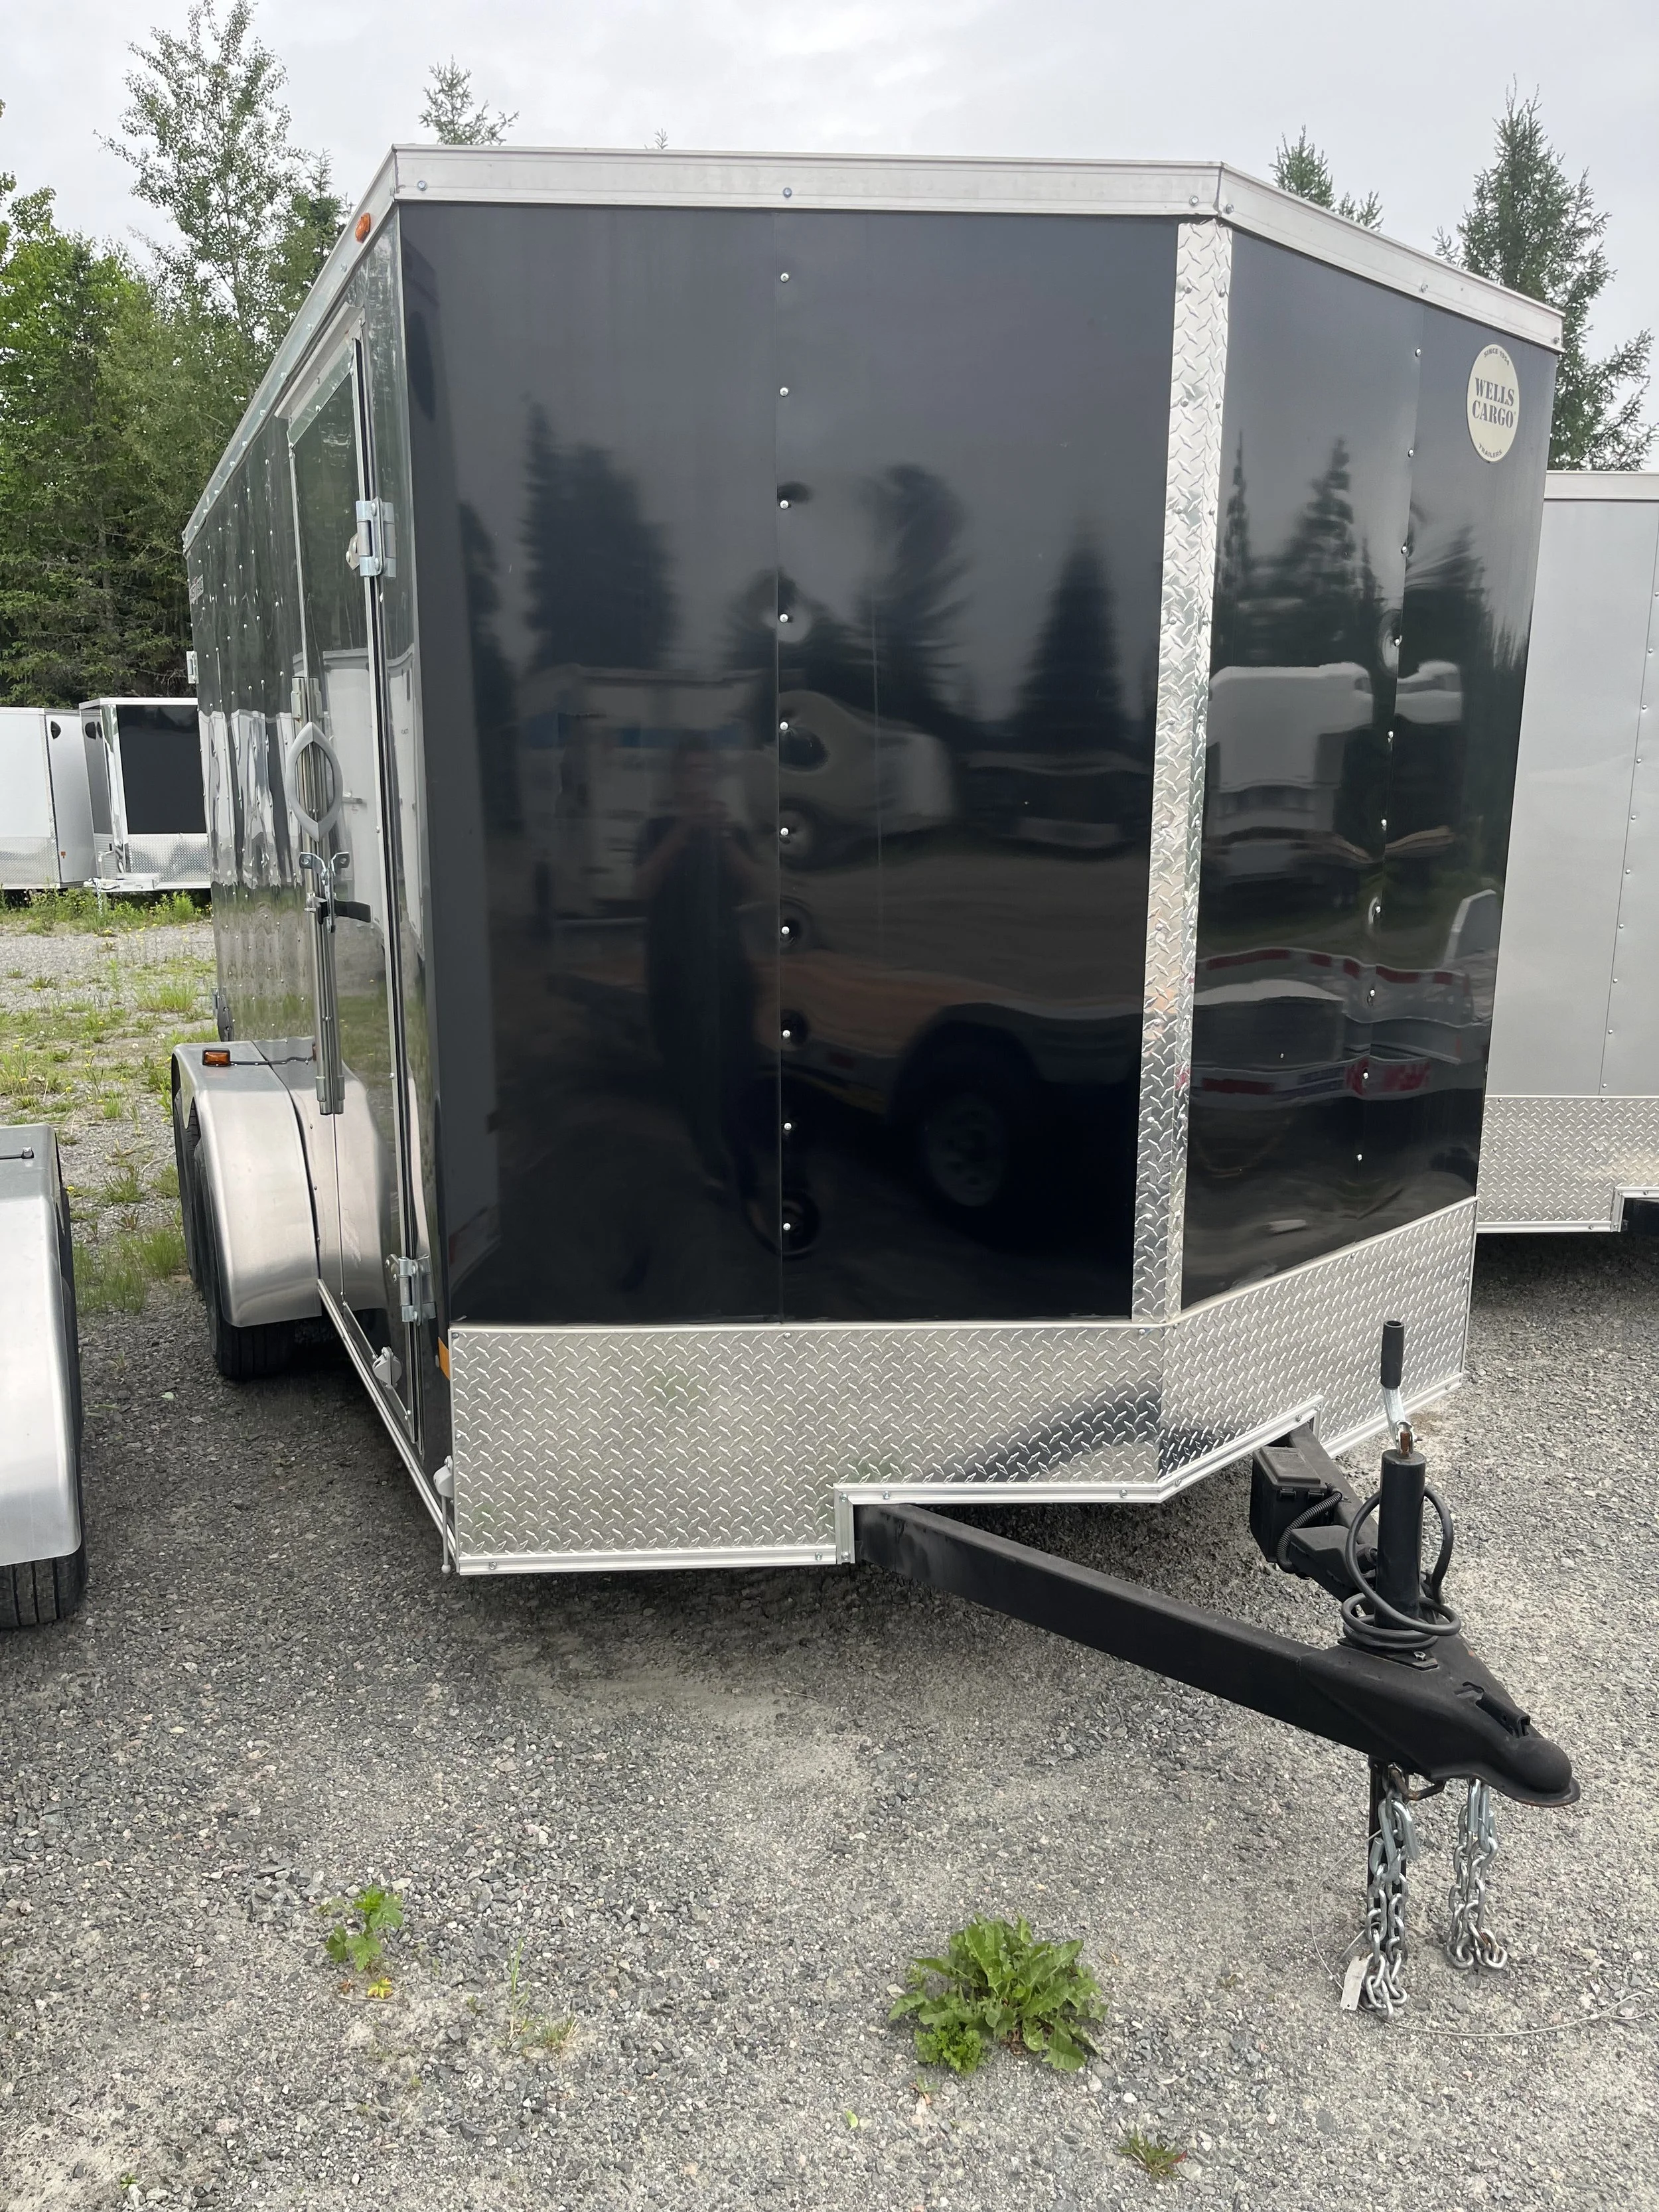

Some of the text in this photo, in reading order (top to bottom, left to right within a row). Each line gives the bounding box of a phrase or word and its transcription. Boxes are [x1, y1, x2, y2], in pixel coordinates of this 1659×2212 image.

[1484, 348, 1498, 358] SINCE
[1475, 377, 1514, 407] WELLS
[1472, 400, 1514, 429] CARGO
[1479, 443, 1502, 458] TRAILERS
